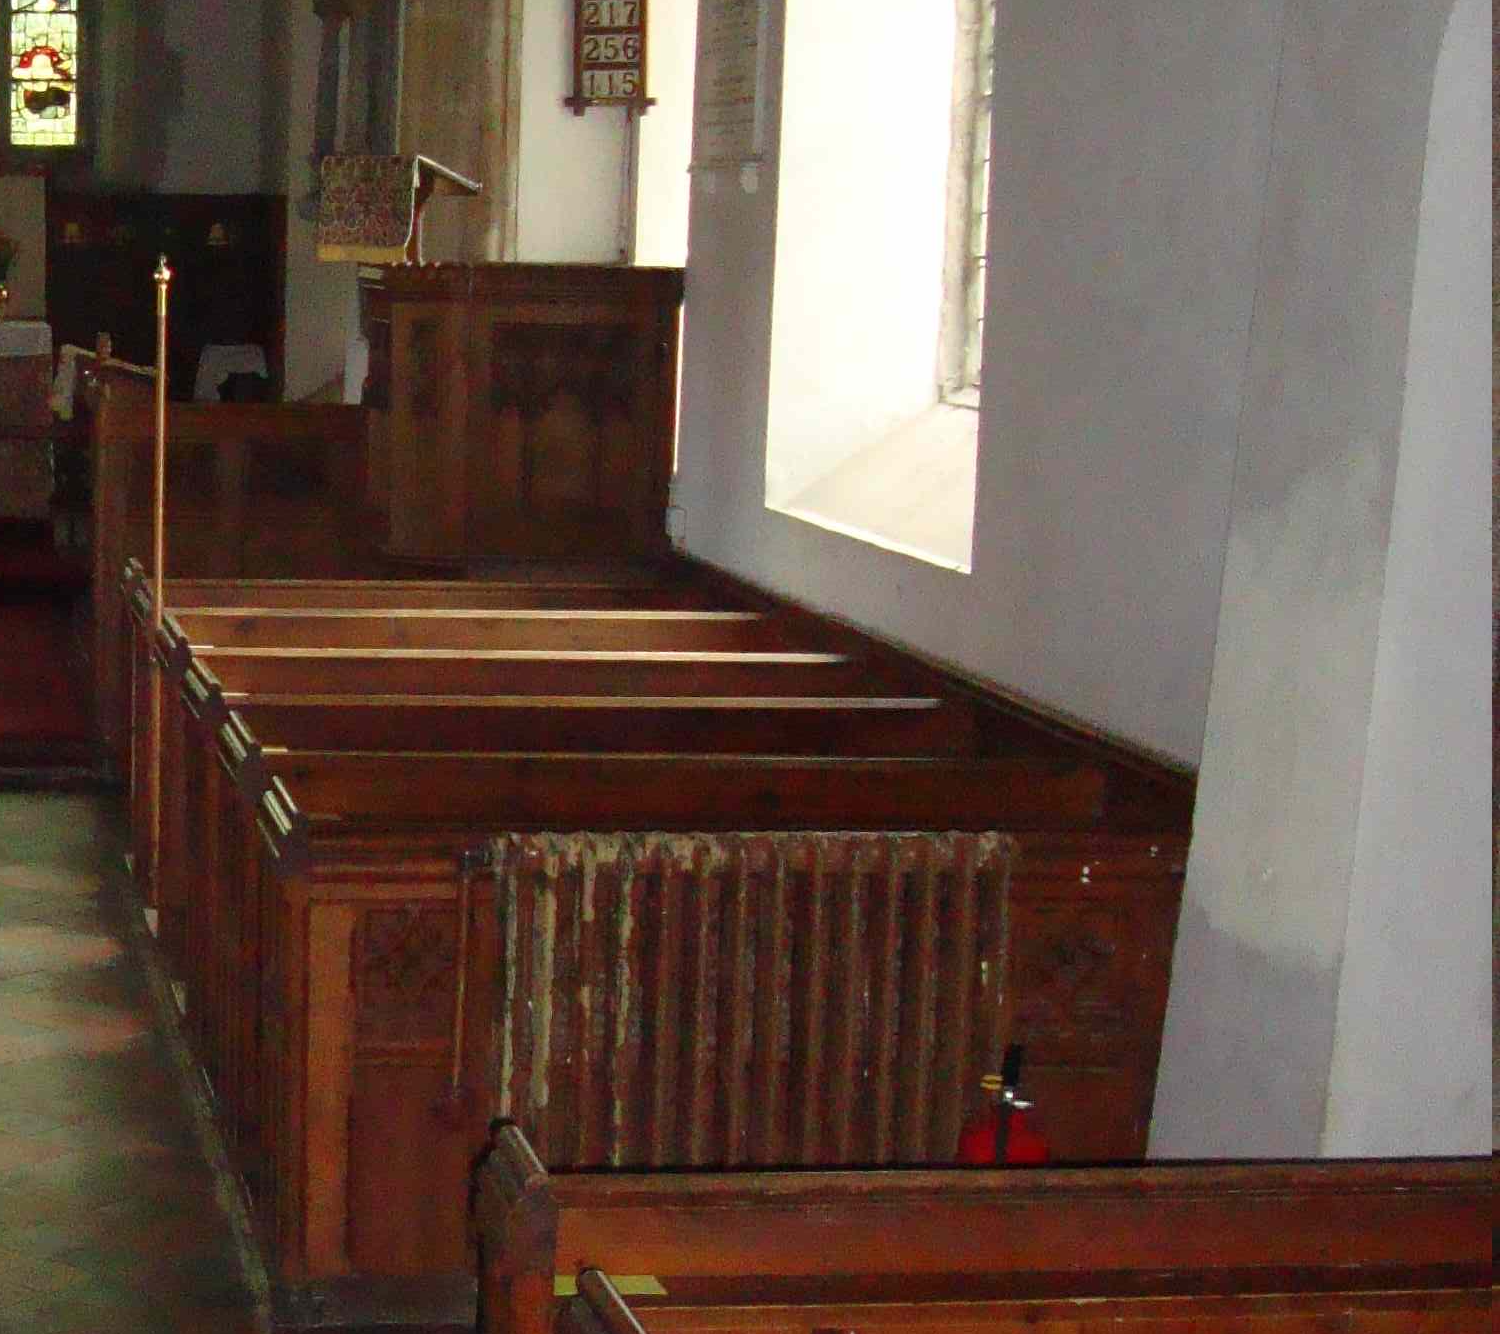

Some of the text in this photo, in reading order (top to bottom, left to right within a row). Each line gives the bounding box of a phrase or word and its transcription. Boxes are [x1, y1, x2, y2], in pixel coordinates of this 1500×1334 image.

[585, 1, 637, 25] 217
[585, 36, 639, 60] 256
[589, 72, 637, 95] 115
